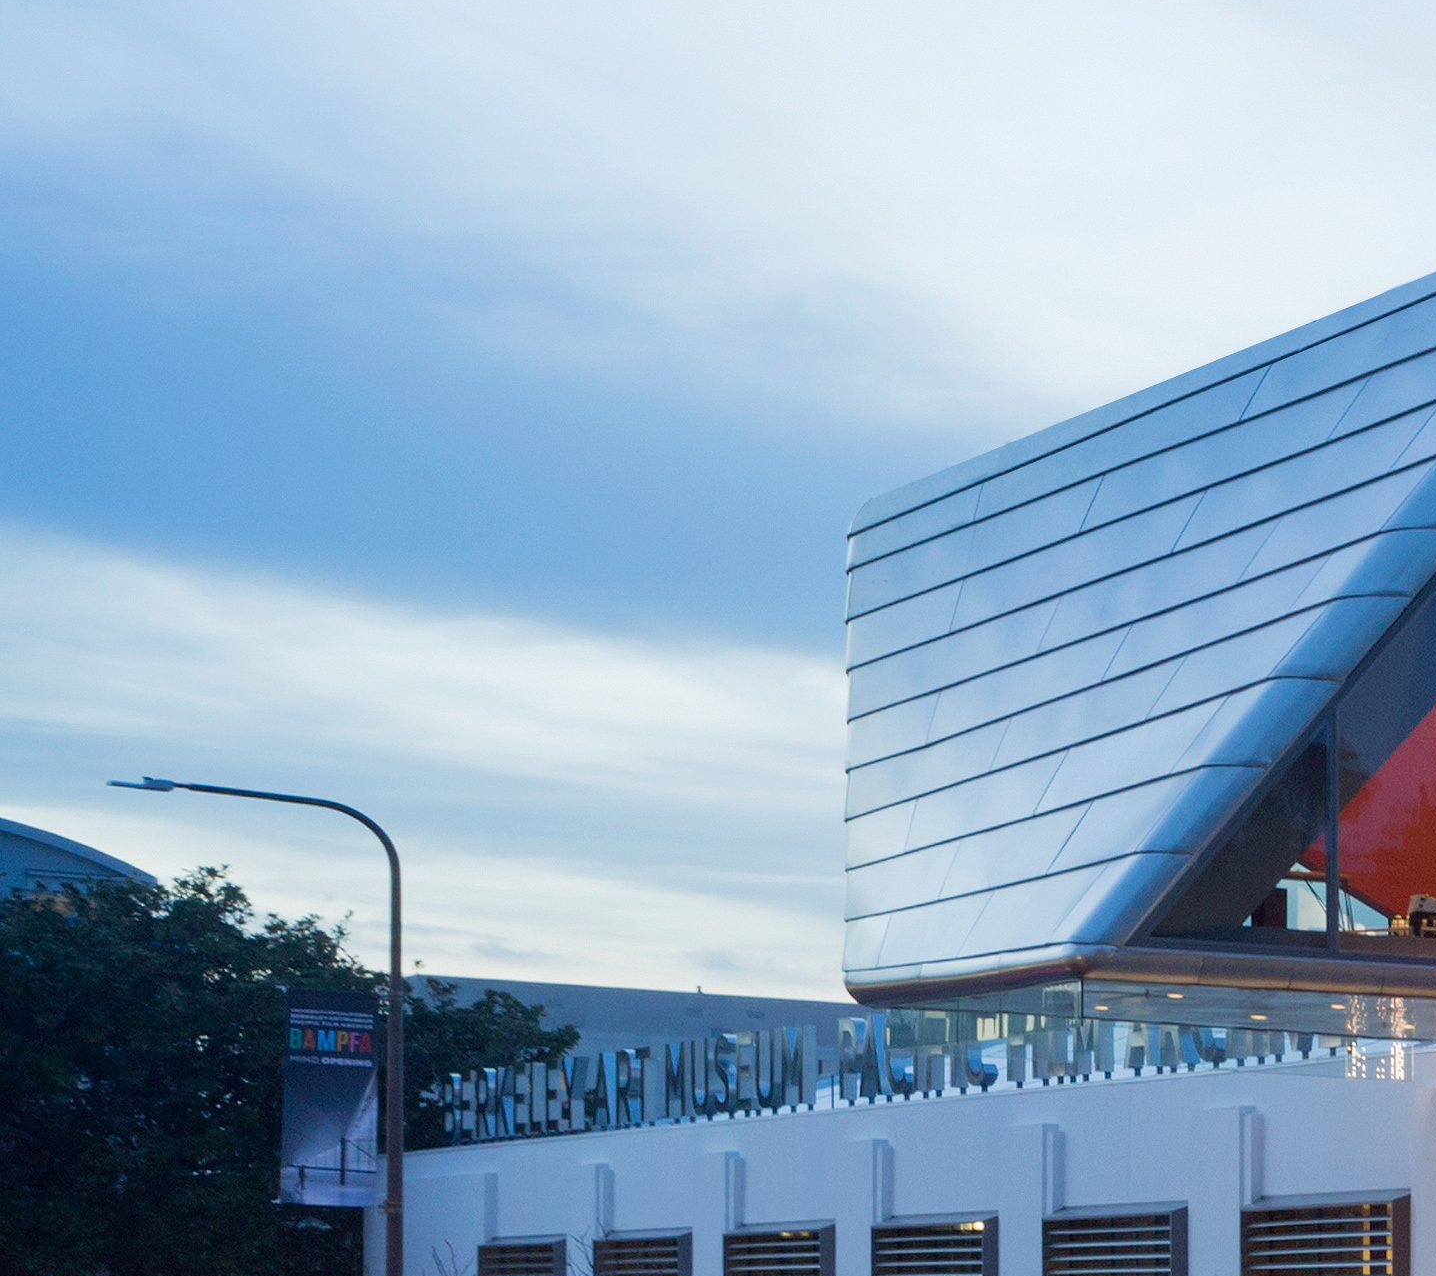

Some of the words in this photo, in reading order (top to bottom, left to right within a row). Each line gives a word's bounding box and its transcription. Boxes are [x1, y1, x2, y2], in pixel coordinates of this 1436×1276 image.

[289, 1027, 372, 1053] BAMPFA
[321, 1056, 373, 1067] OPENING
[442, 1055, 591, 1145] BERKELEY
[594, 1044, 652, 1128] ART
[665, 1024, 814, 1119] MUSEUM
